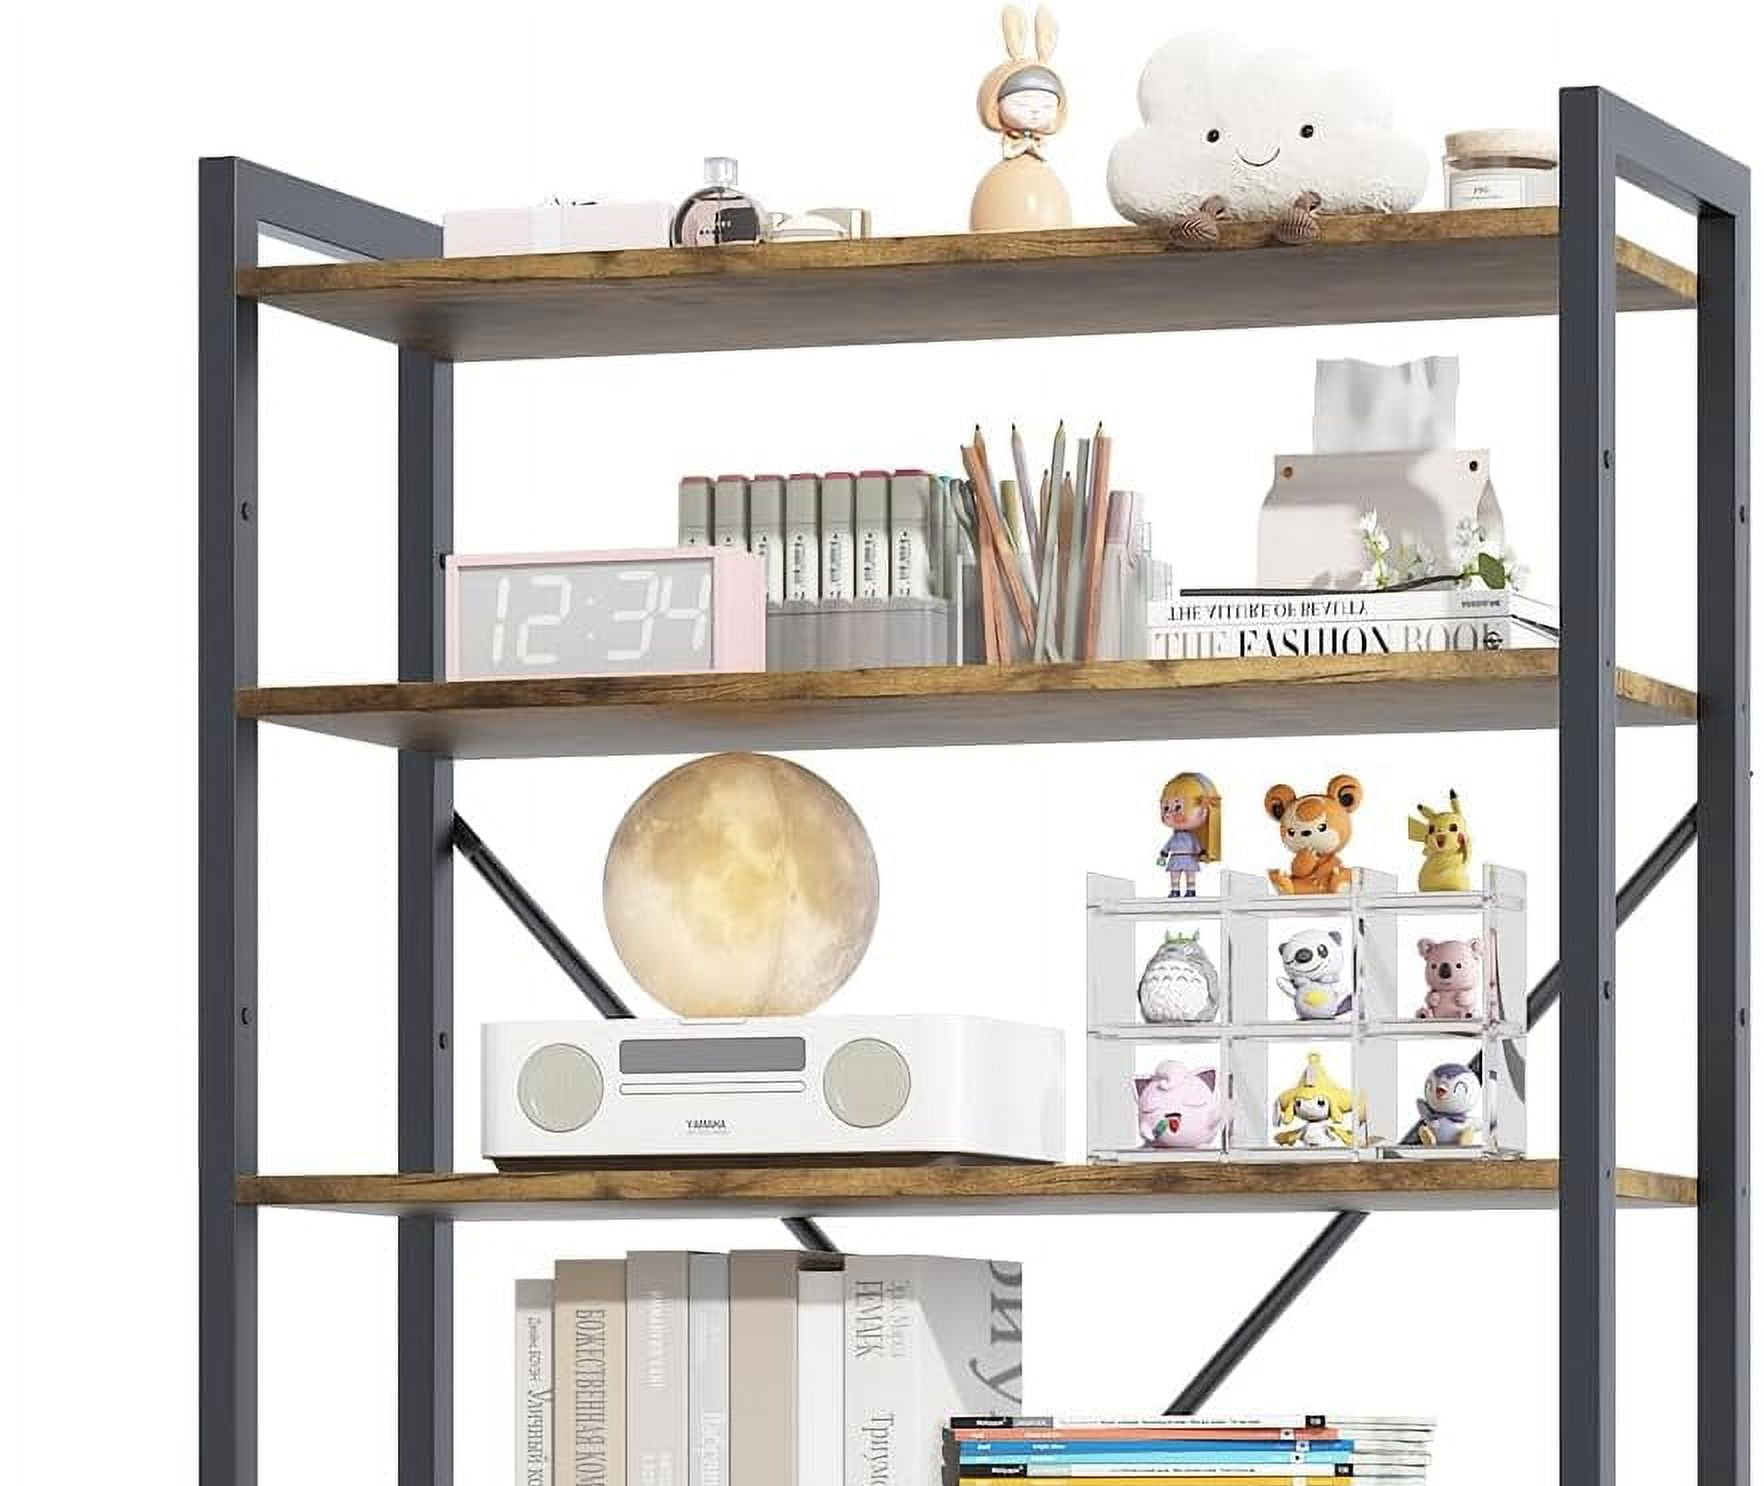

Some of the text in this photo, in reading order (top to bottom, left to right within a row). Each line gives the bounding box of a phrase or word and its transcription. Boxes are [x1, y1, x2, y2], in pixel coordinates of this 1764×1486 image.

[493, 570, 712, 665] 12:34
[1238, 626, 1391, 657] FASHION
[575, 1309, 606, 1444] БОЖЕСТВЕННАЯ
[528, 1388, 553, 1464] Уличный
